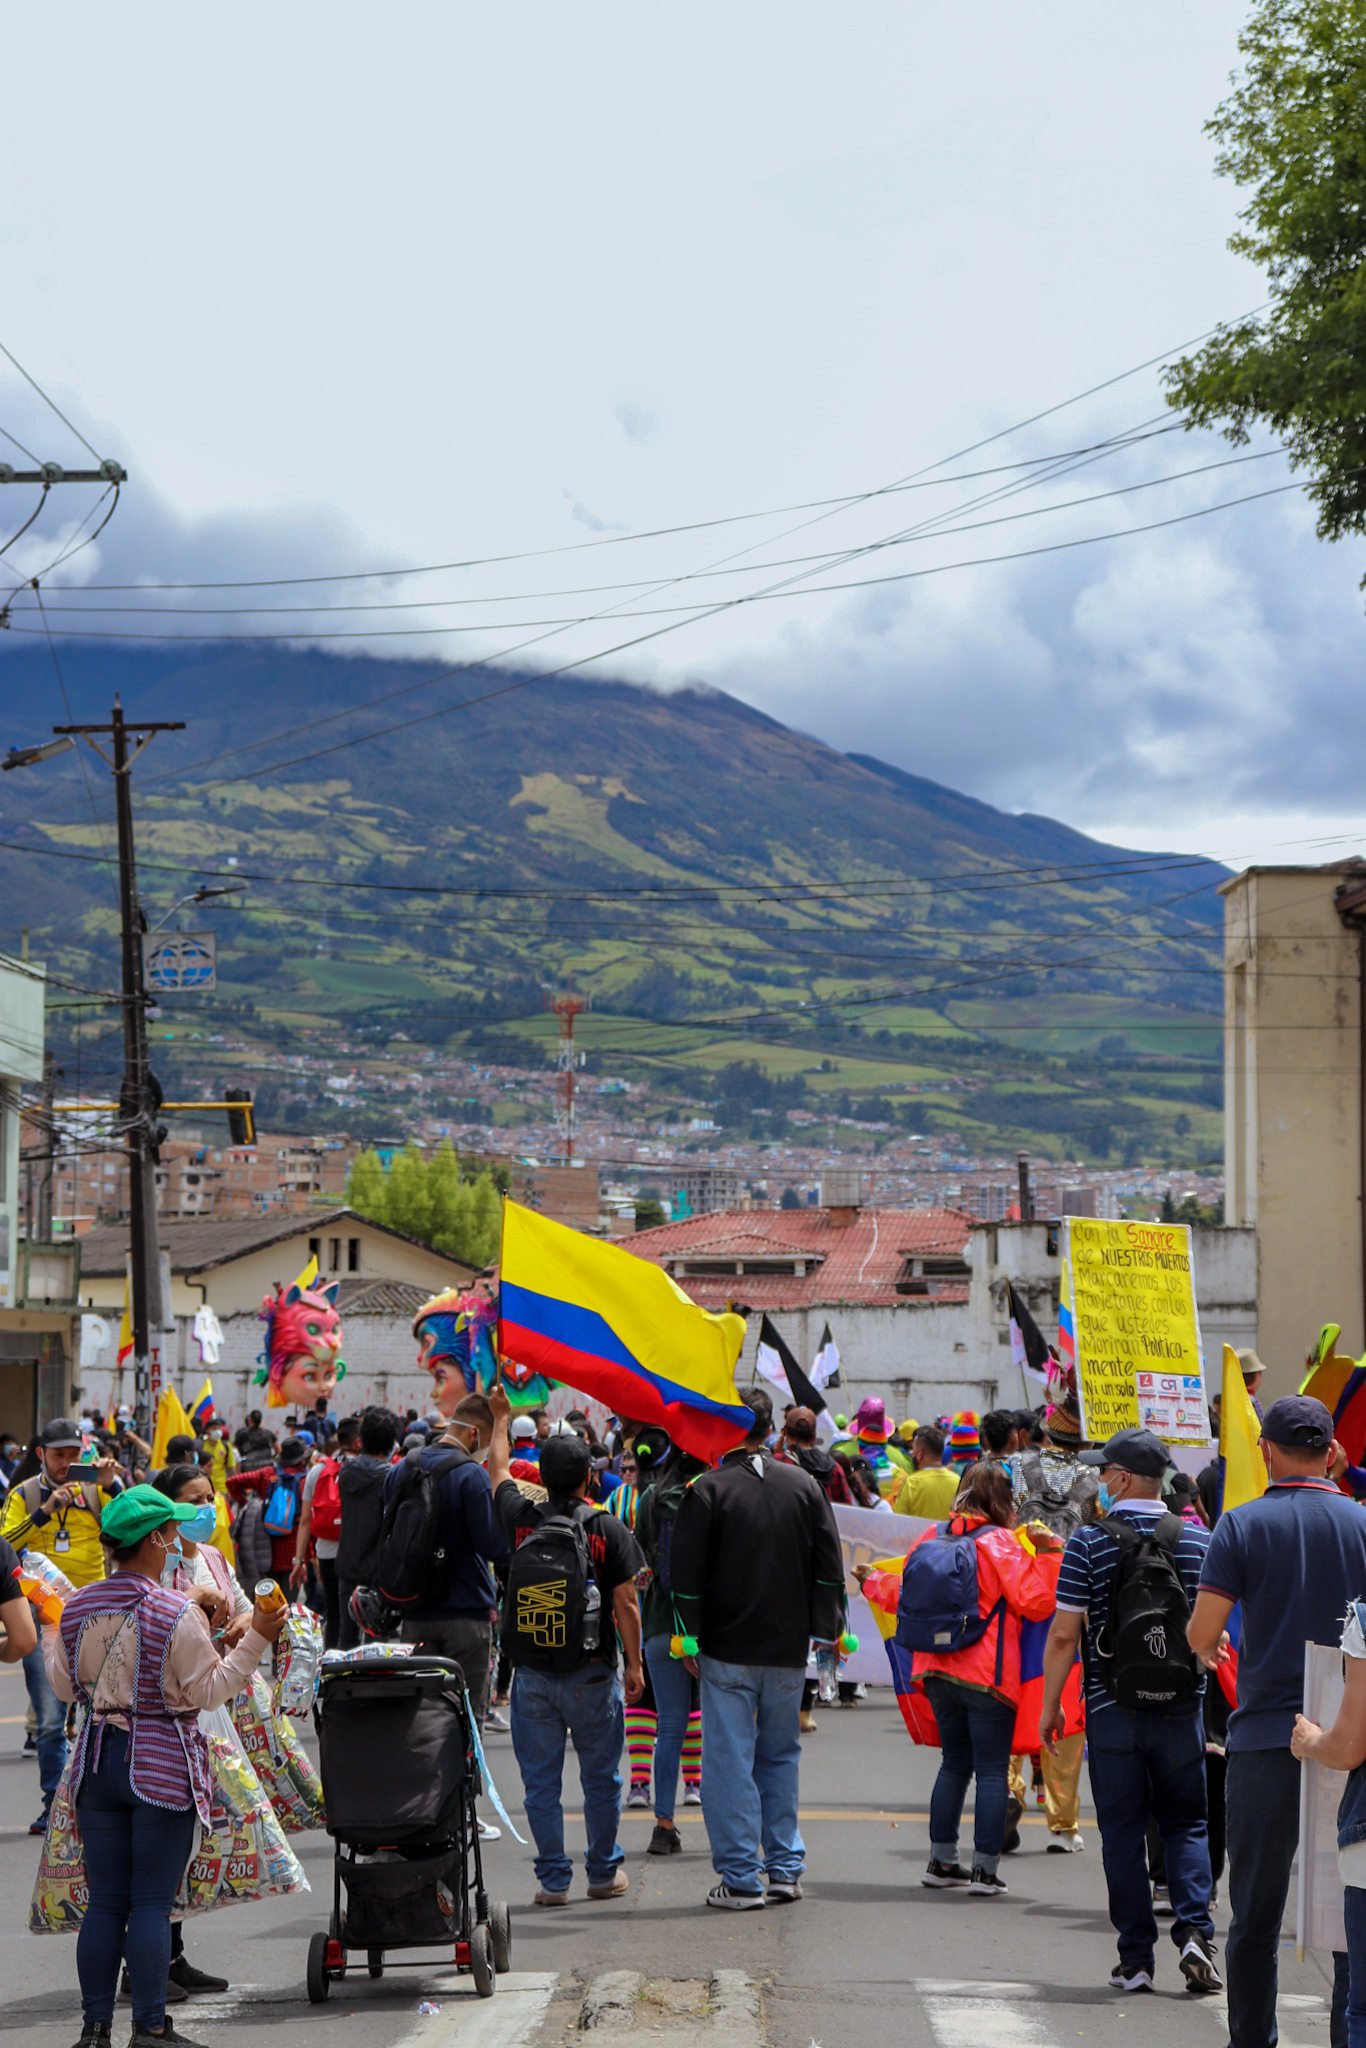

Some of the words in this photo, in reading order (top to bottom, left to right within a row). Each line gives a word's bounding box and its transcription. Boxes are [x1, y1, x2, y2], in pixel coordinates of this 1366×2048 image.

[1126, 1223, 1175, 1252] Sangre
[1077, 1241, 1094, 1265] de
[1100, 1248, 1154, 1268] NUESTROS
[1154, 1252, 1191, 1272] MUERTOS
[1078, 1268, 1160, 1291] Marcaremos
[1081, 1314, 1108, 1338] que
[1087, 1356, 1135, 1377] mente
[1085, 1380, 1099, 1396] Ni
[1116, 1381, 1135, 1398] solo
[1111, 1401, 1130, 1418] por
